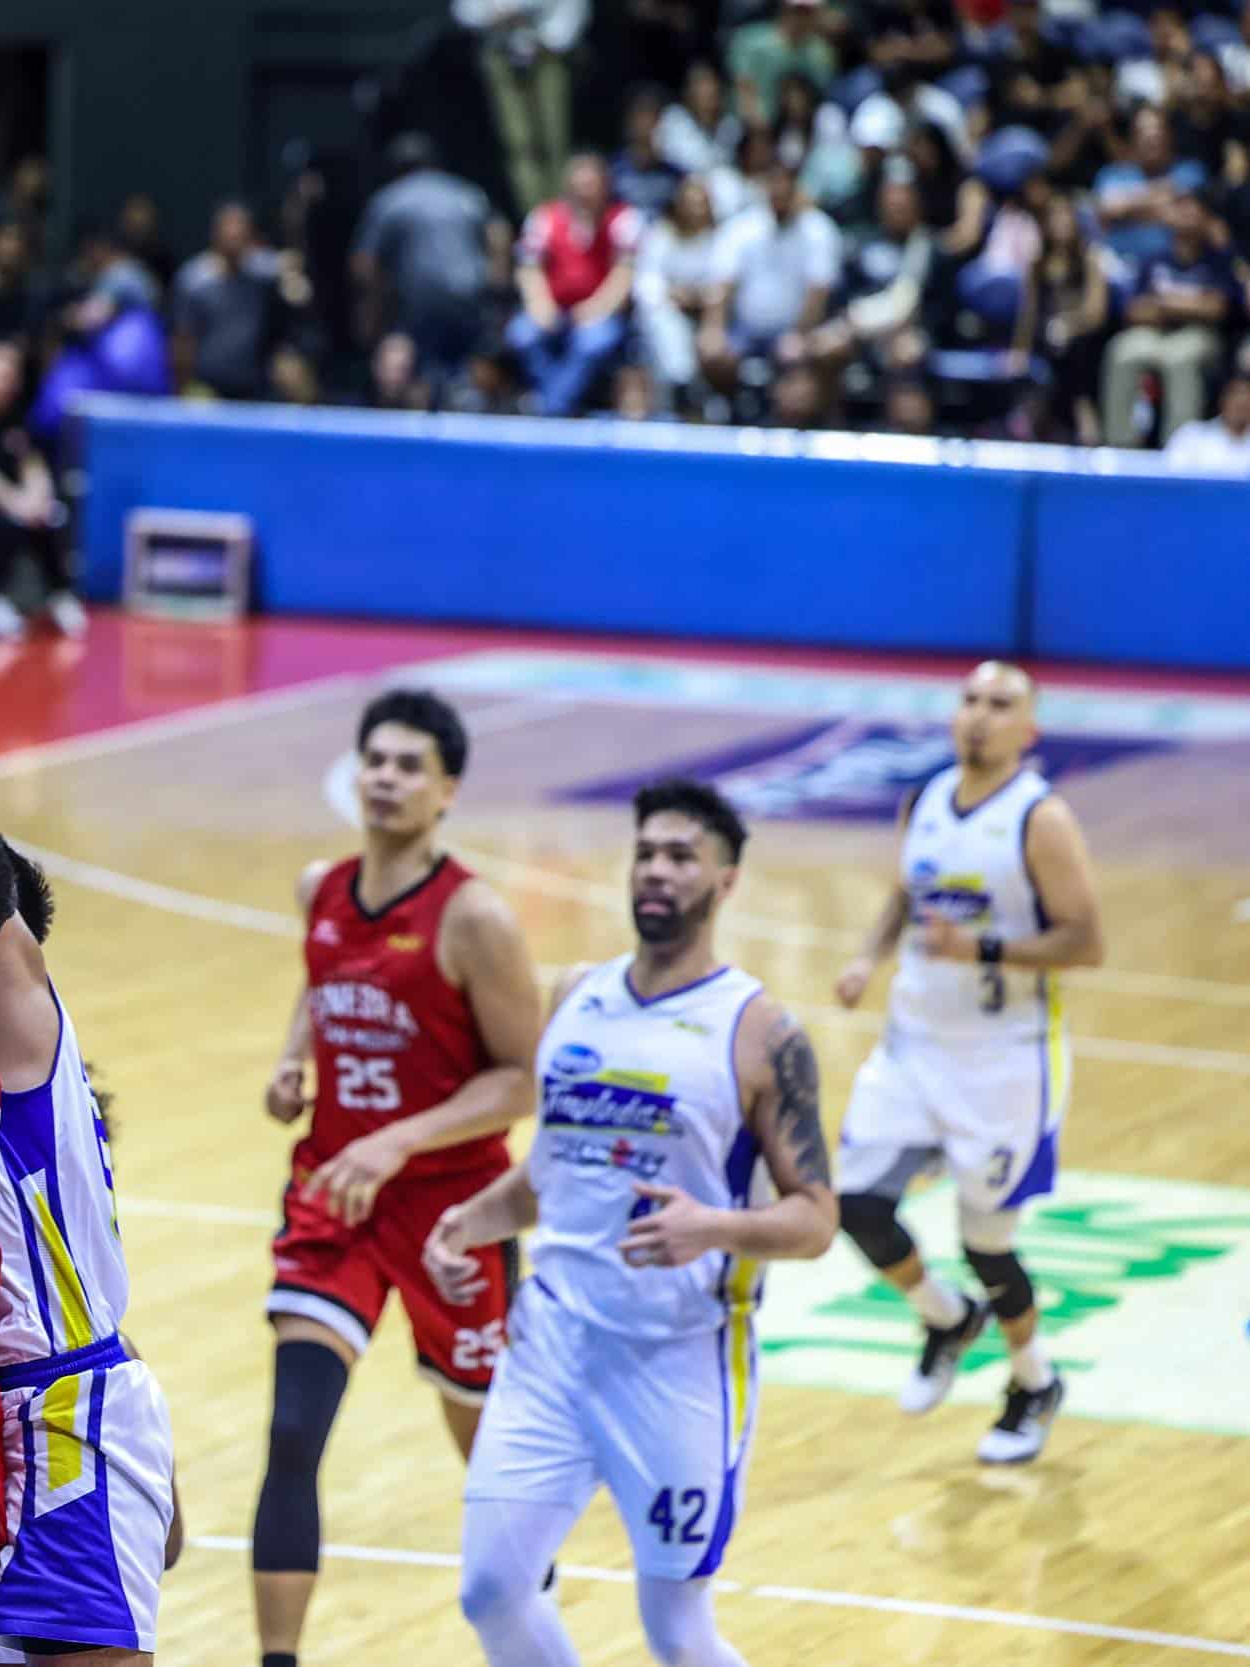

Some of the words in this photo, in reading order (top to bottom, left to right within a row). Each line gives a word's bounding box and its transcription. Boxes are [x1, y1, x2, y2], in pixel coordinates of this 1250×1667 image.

[334, 1054, 402, 1111] 25
[987, 1147, 1015, 1188] 3
[647, 1485, 707, 1544] 42
